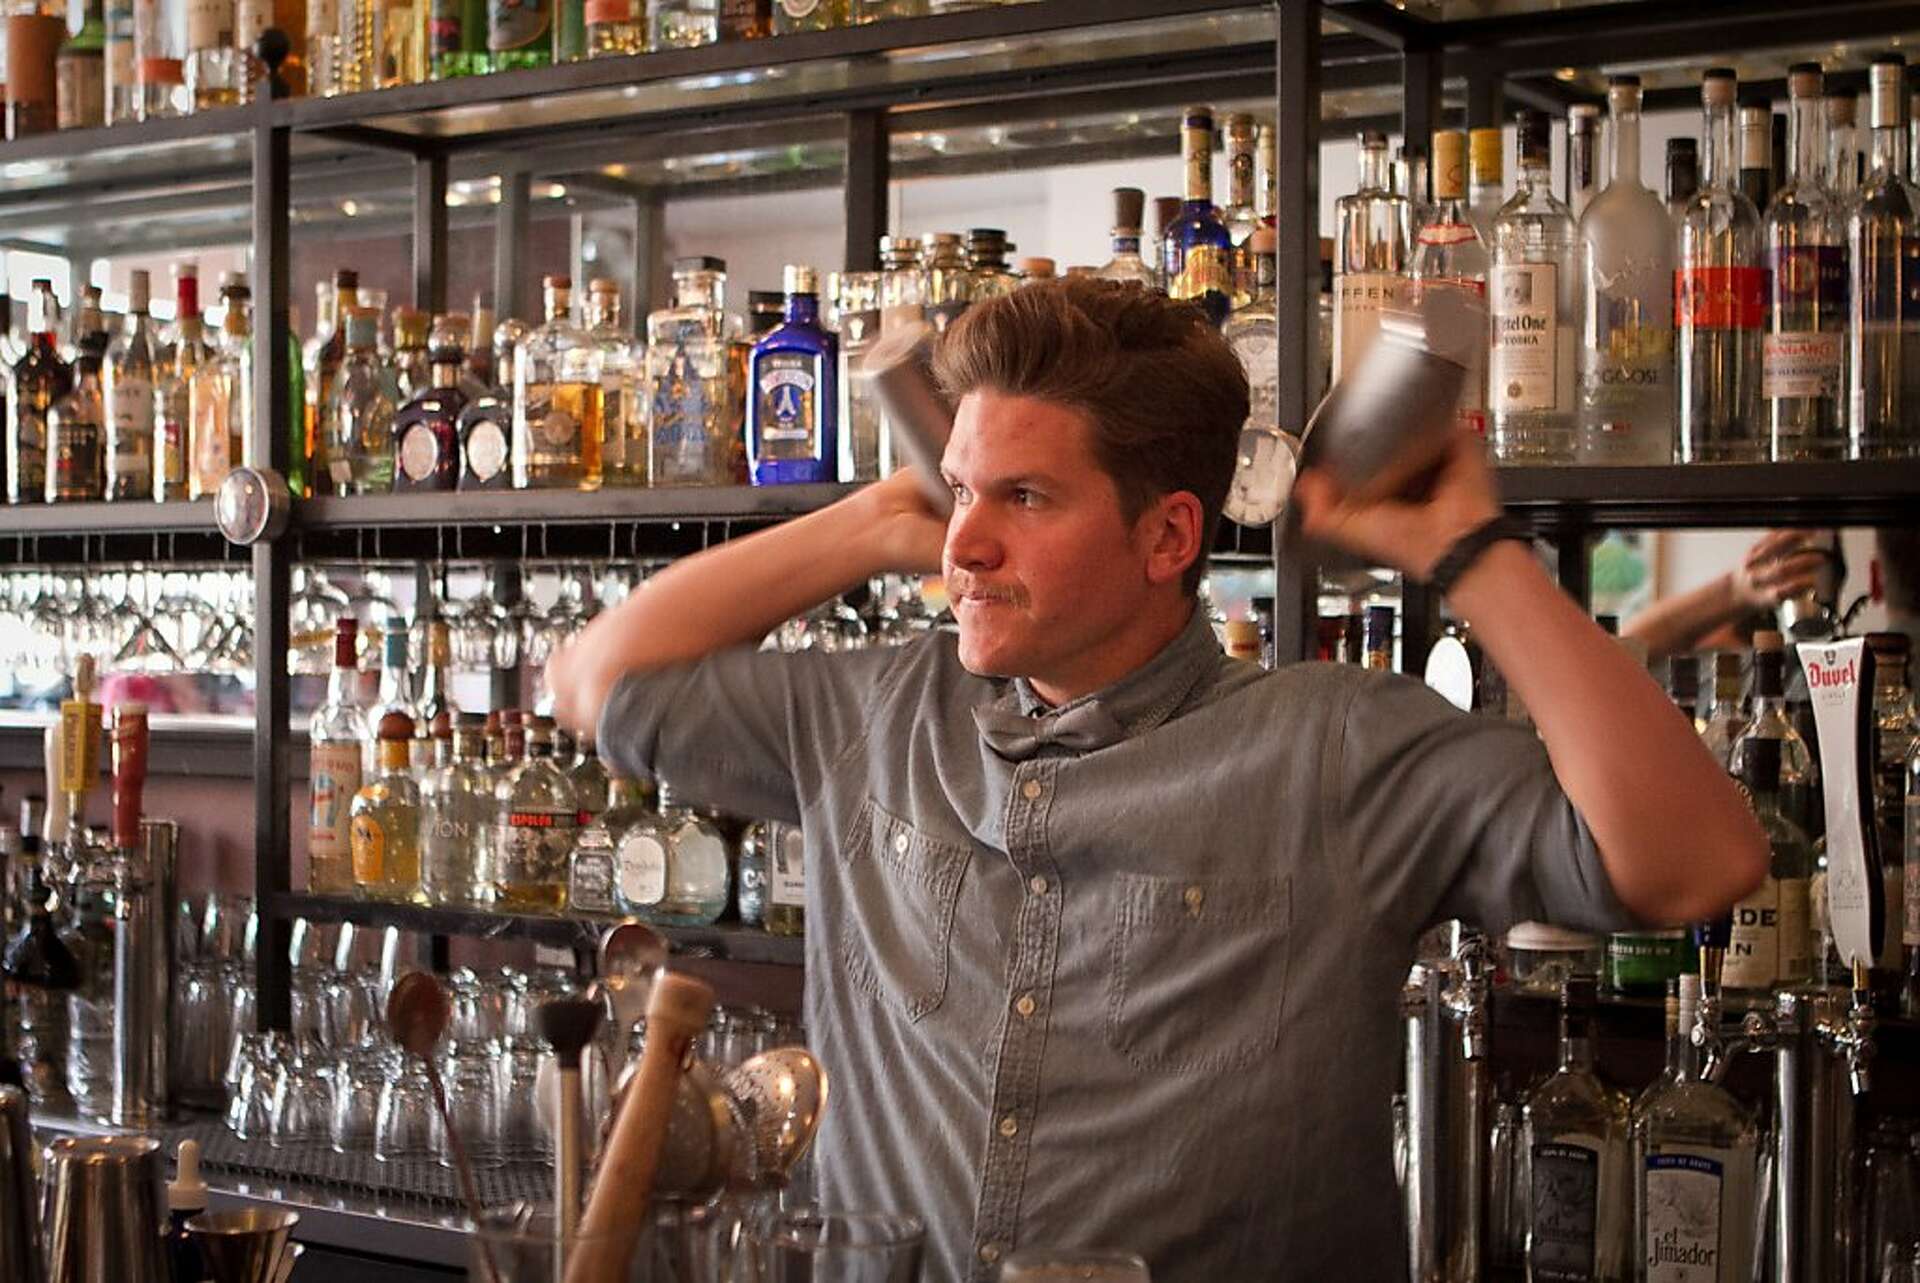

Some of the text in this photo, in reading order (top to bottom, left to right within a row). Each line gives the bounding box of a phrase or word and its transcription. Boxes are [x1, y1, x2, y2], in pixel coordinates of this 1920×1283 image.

[1522, 314, 1546, 331] One
[1808, 657, 1856, 688] Duvel
[1732, 908, 1777, 927] DE
[1664, 1228, 1678, 1246] el
[1649, 1238, 1716, 1267] Jimador
